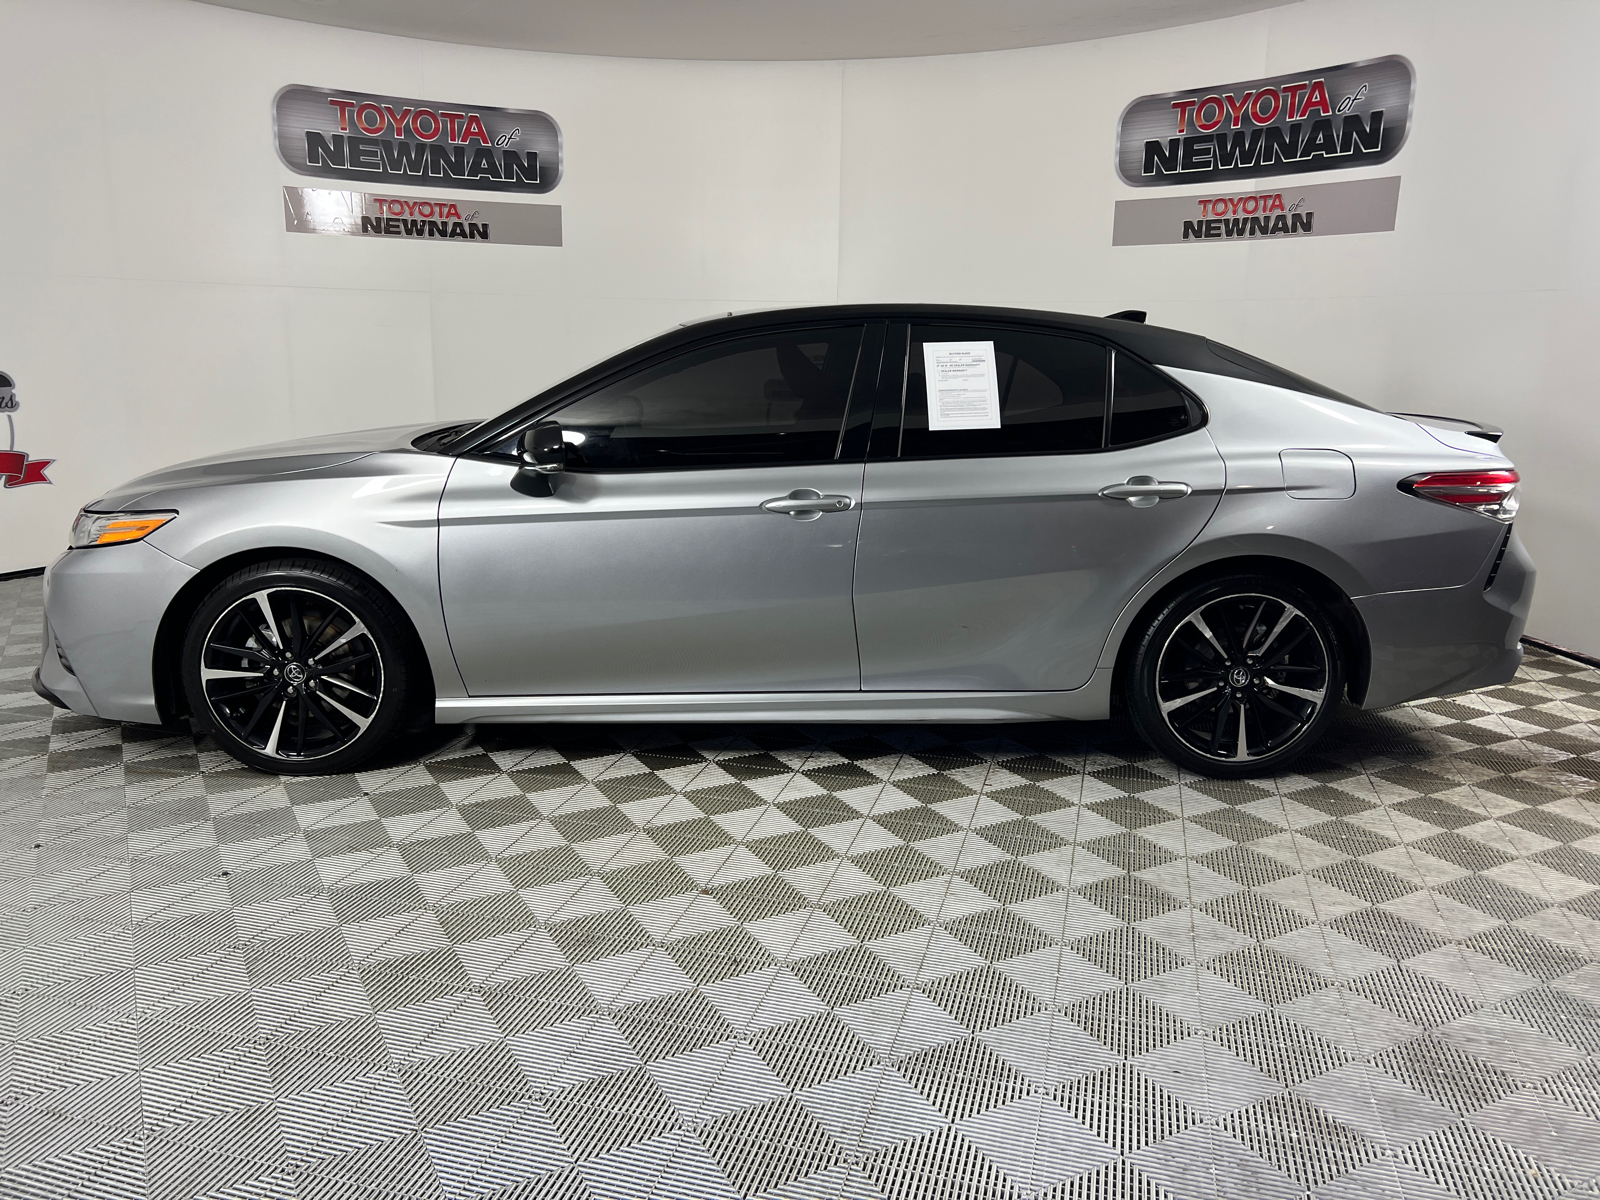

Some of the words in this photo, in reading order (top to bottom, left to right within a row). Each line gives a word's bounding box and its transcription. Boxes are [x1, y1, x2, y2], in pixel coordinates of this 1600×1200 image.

[328, 98, 491, 146] TOYOTA
[495, 128, 521, 147] of
[1171, 78, 1332, 135] TOYOTA
[1336, 83, 1368, 114] of
[305, 131, 539, 183] NEWNAN
[1142, 109, 1385, 175] NEWNAN
[373, 198, 462, 220] TOYOTA
[464, 210, 479, 222] of
[1198, 193, 1286, 218] TOYOTA
[1288, 197, 1305, 212] of
[361, 216, 490, 241] NEWNAN
[1182, 211, 1315, 240] NEWNAN
